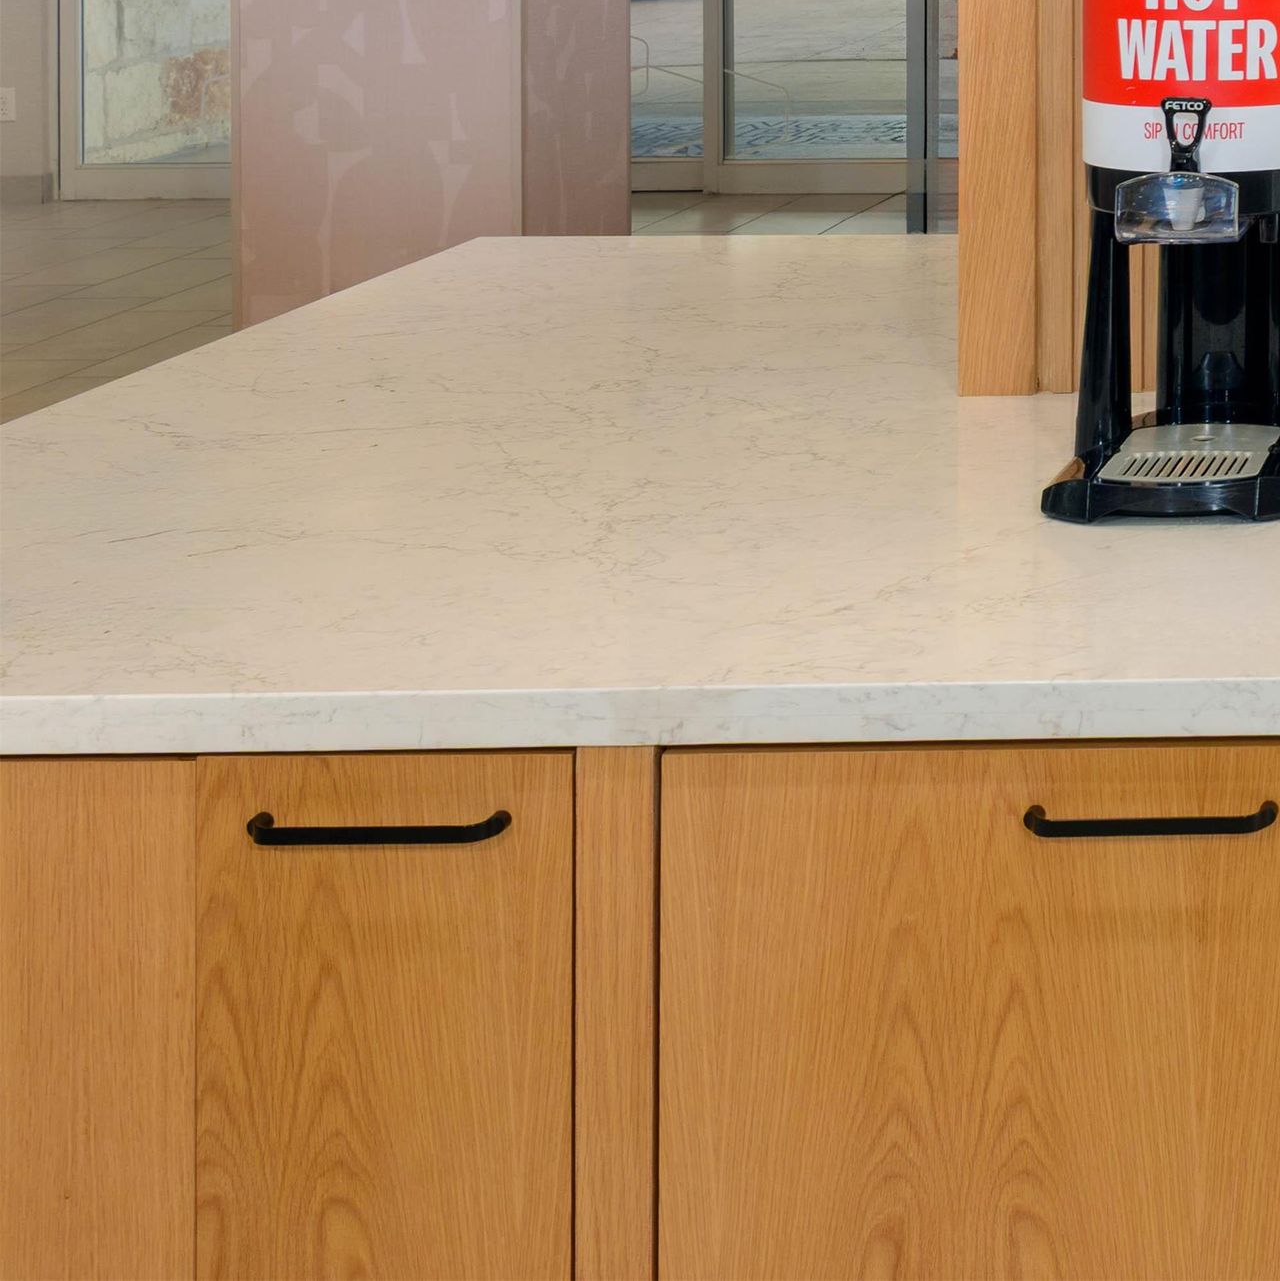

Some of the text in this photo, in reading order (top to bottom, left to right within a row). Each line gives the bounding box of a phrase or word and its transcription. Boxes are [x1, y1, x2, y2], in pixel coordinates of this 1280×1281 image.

[1117, 18, 1278, 81] WATER
[1165, 101, 1204, 111] FETCO
[1144, 122, 1163, 139] SIP
